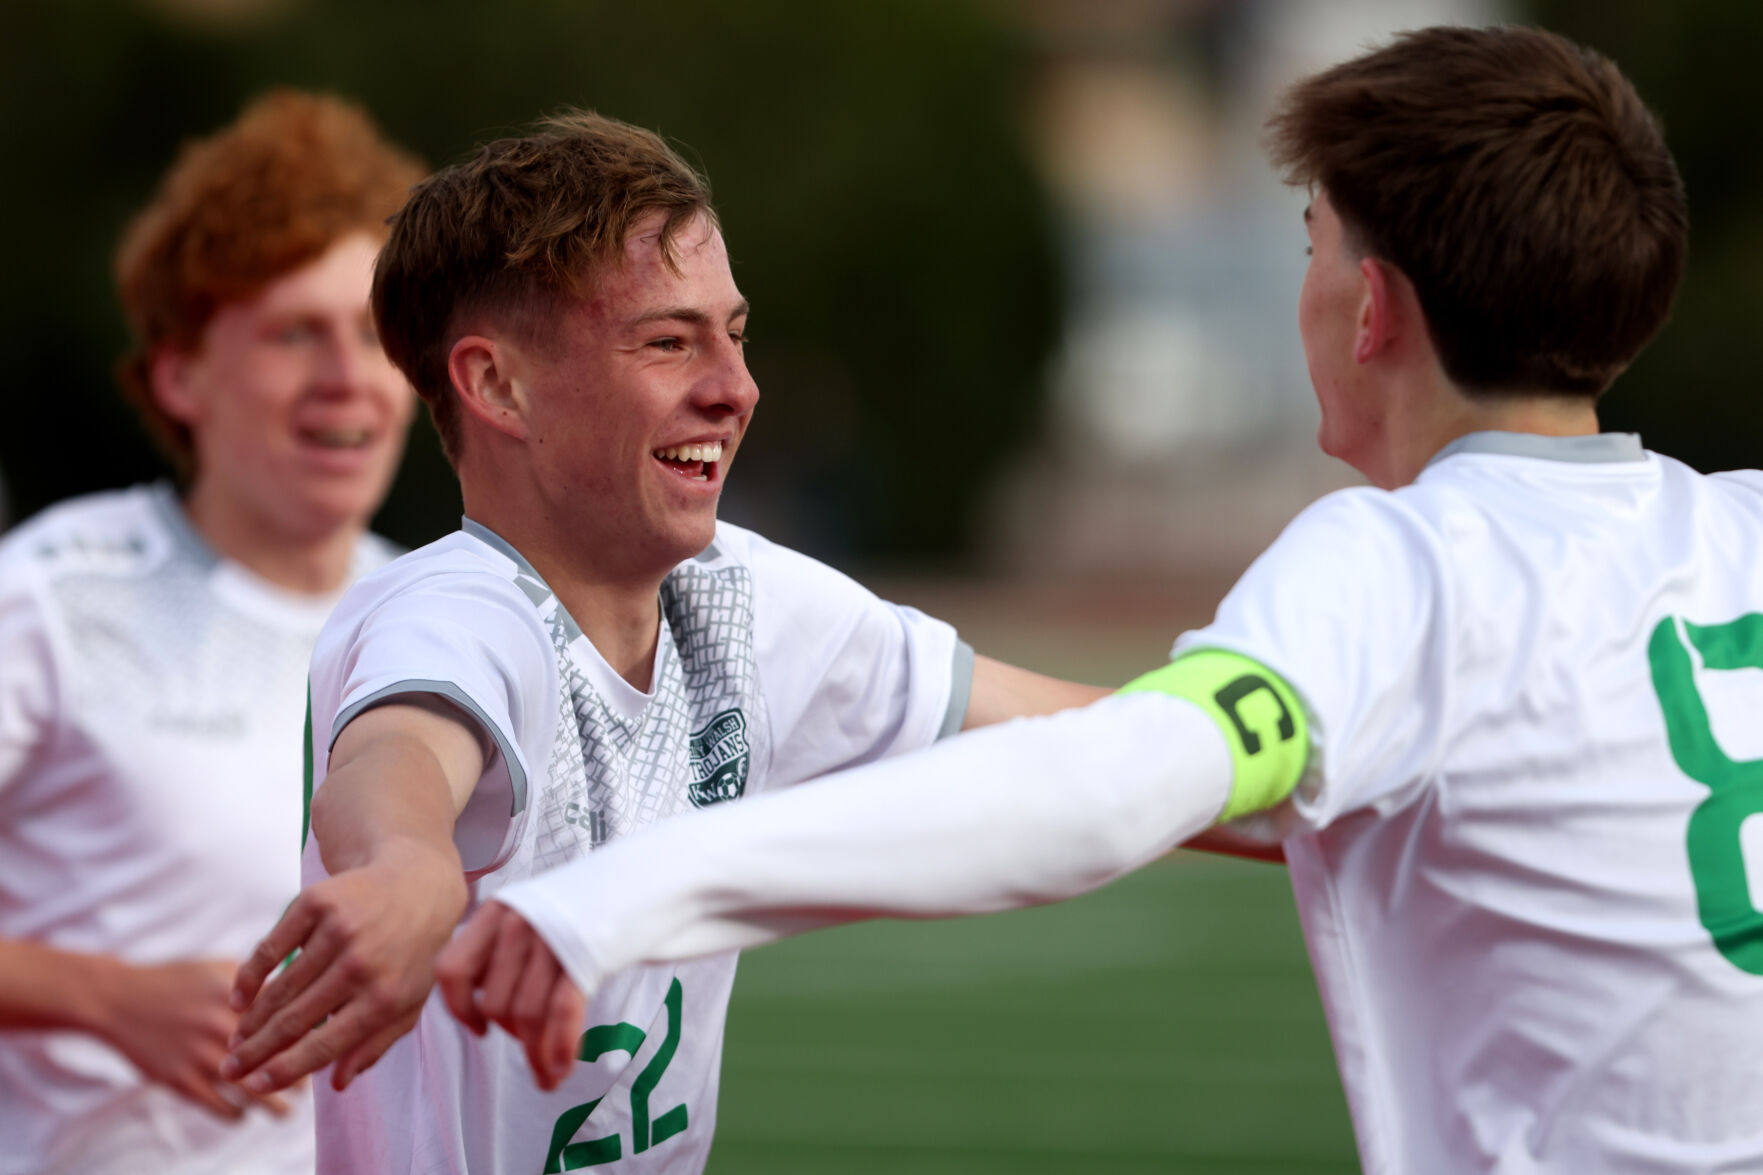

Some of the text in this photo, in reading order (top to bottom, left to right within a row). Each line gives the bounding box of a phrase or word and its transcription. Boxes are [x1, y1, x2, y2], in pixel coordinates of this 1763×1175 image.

[1214, 675, 1294, 755] C
[689, 732, 745, 781] TROJANS
[543, 976, 688, 1175] 22
